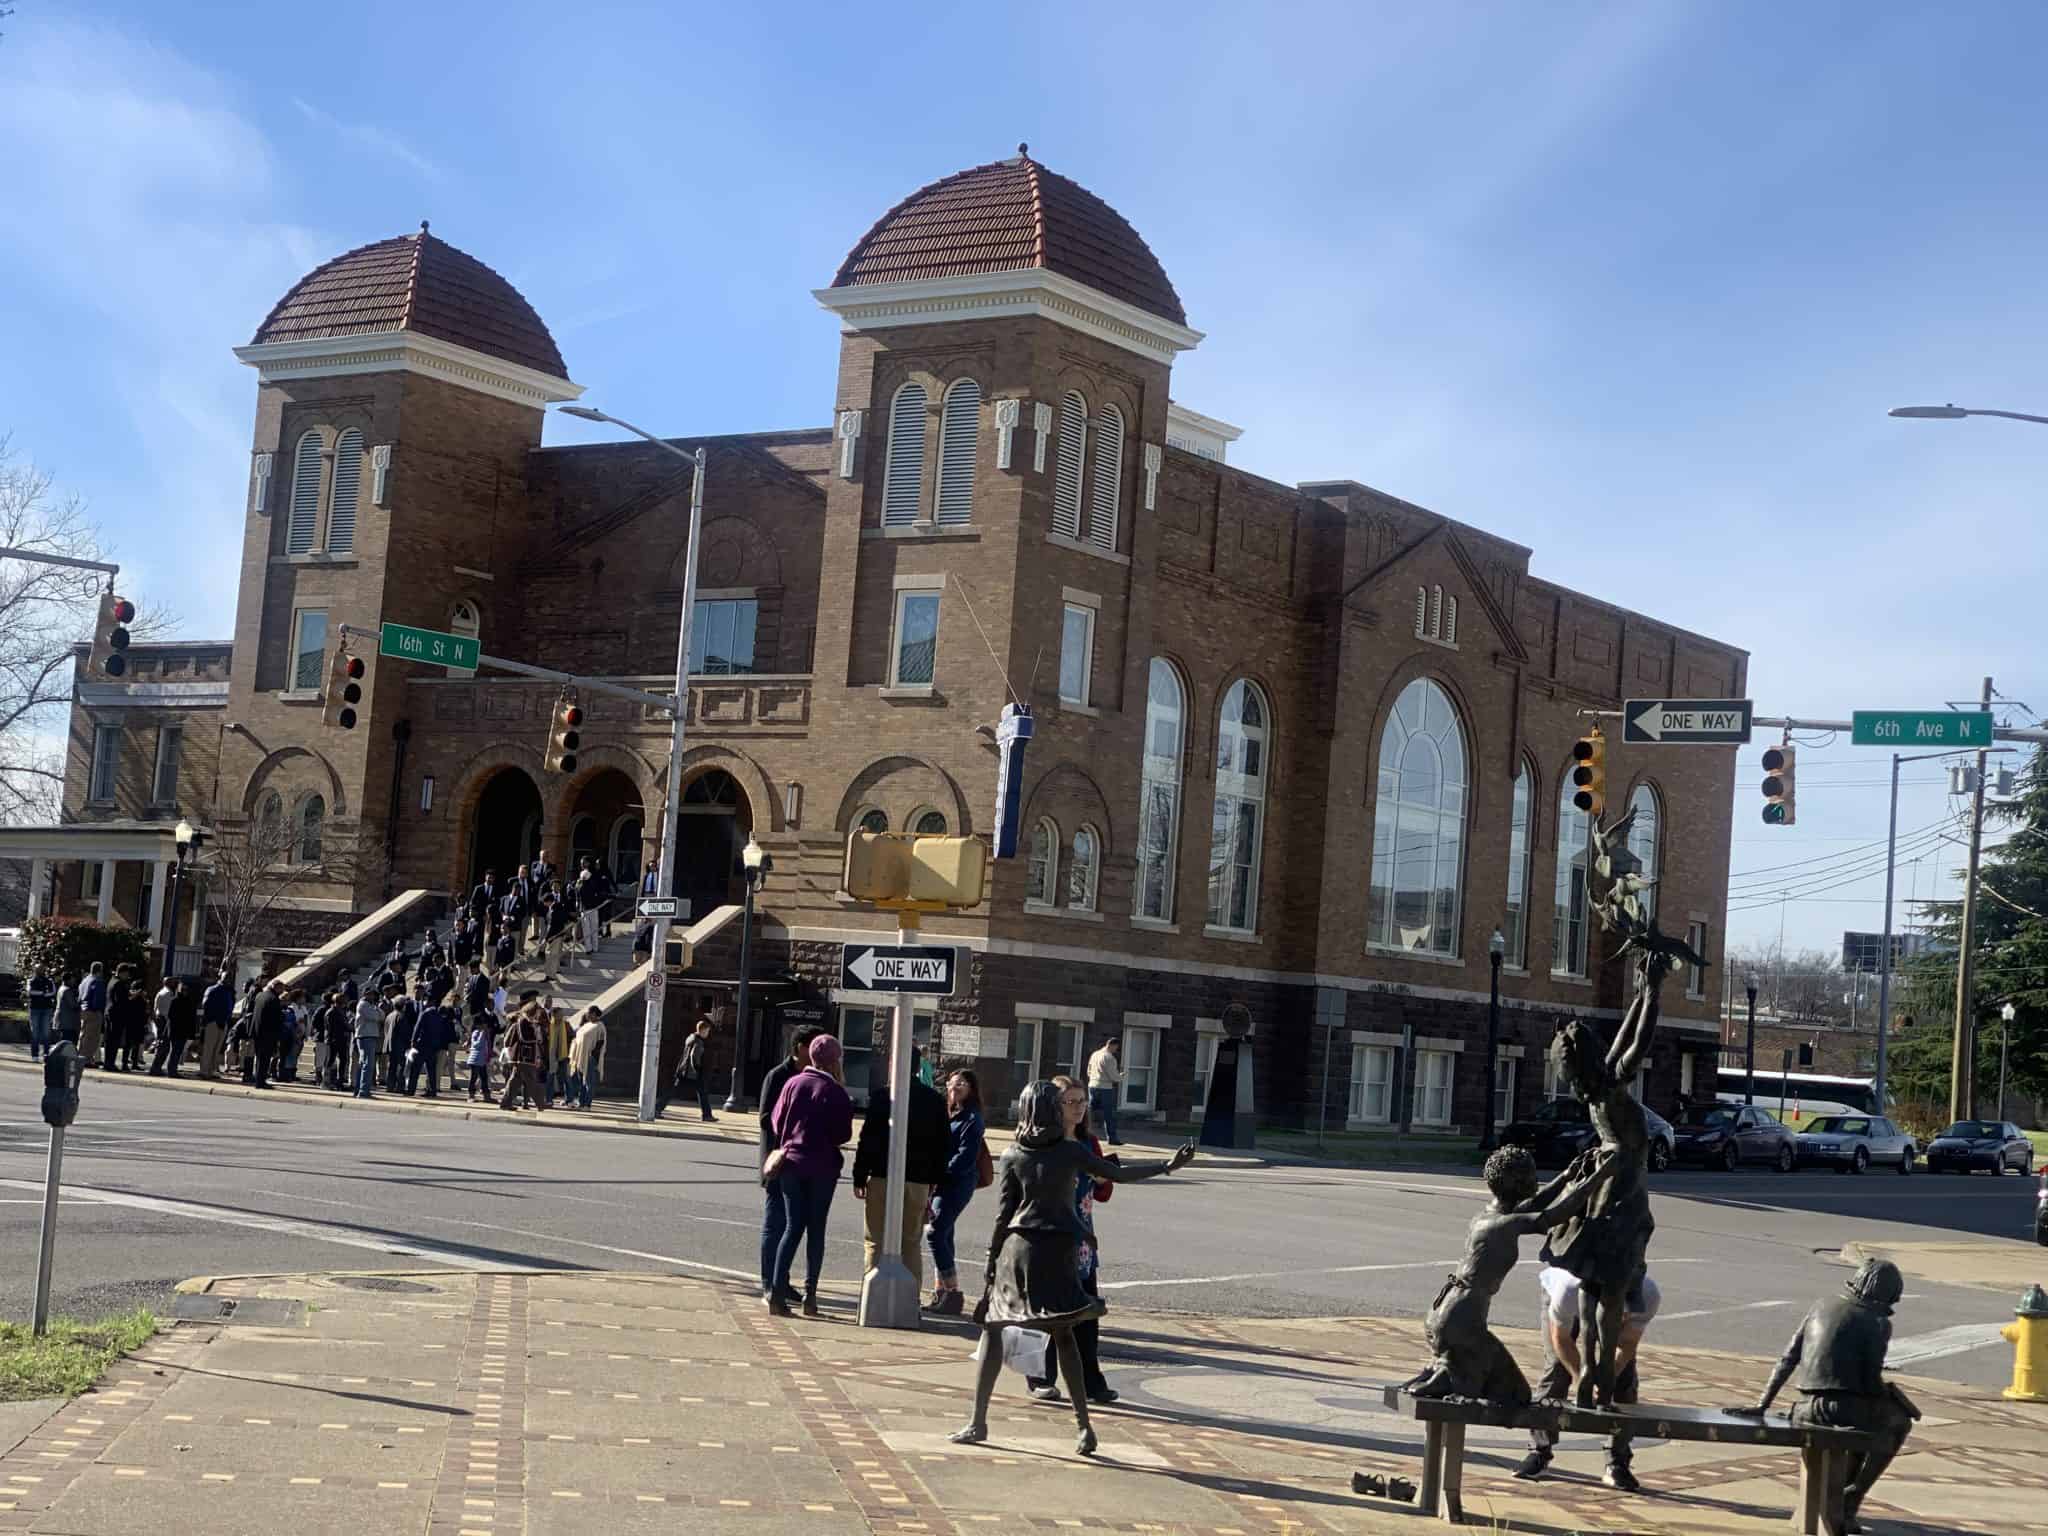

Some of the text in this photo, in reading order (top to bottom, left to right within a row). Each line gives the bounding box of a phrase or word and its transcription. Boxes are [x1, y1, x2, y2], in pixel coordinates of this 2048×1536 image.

[399, 633, 464, 660] 16th St N
[1662, 713, 1736, 729] ONE WAY
[1874, 720, 1971, 737] 6th Ave N
[648, 903, 673, 912] ONE WAY
[875, 959, 943, 979] ONE WAY
